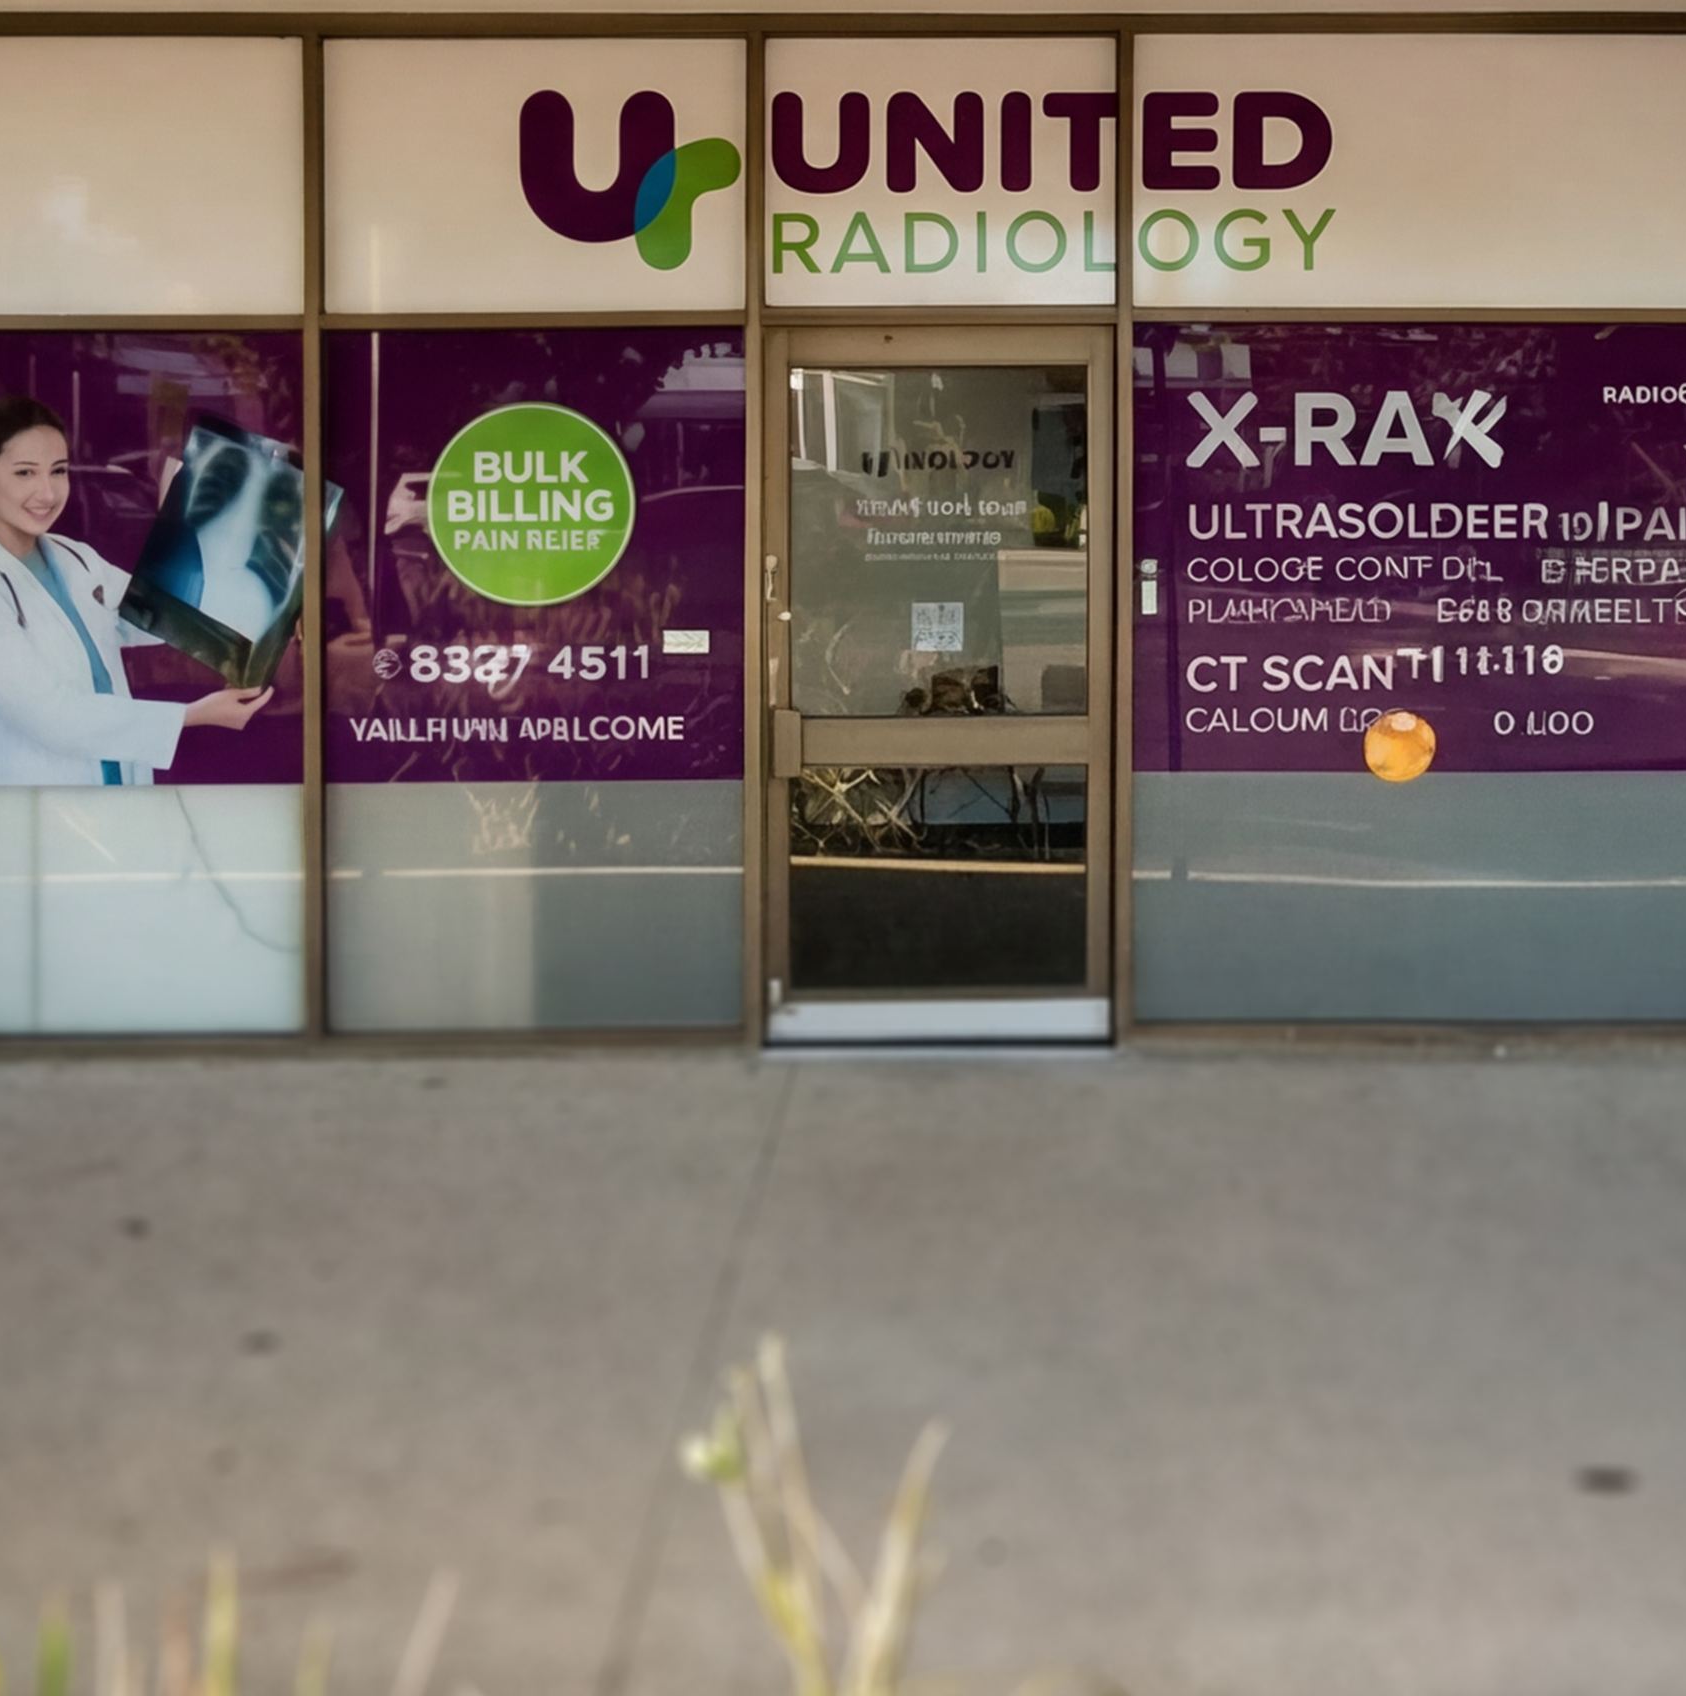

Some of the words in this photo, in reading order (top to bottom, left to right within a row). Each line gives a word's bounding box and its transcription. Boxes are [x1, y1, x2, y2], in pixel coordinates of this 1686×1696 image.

[771, 90, 1333, 193] UNITED
[771, 208, 1337, 274] RADIOLOGY
[474, 451, 588, 483] BULK
[447, 489, 614, 522] BILLING
[453, 529, 519, 551] PAIN
[547, 644, 649, 681] 4511
[1186, 656, 1247, 692] CT
[1262, 656, 1393, 692] SCAN
